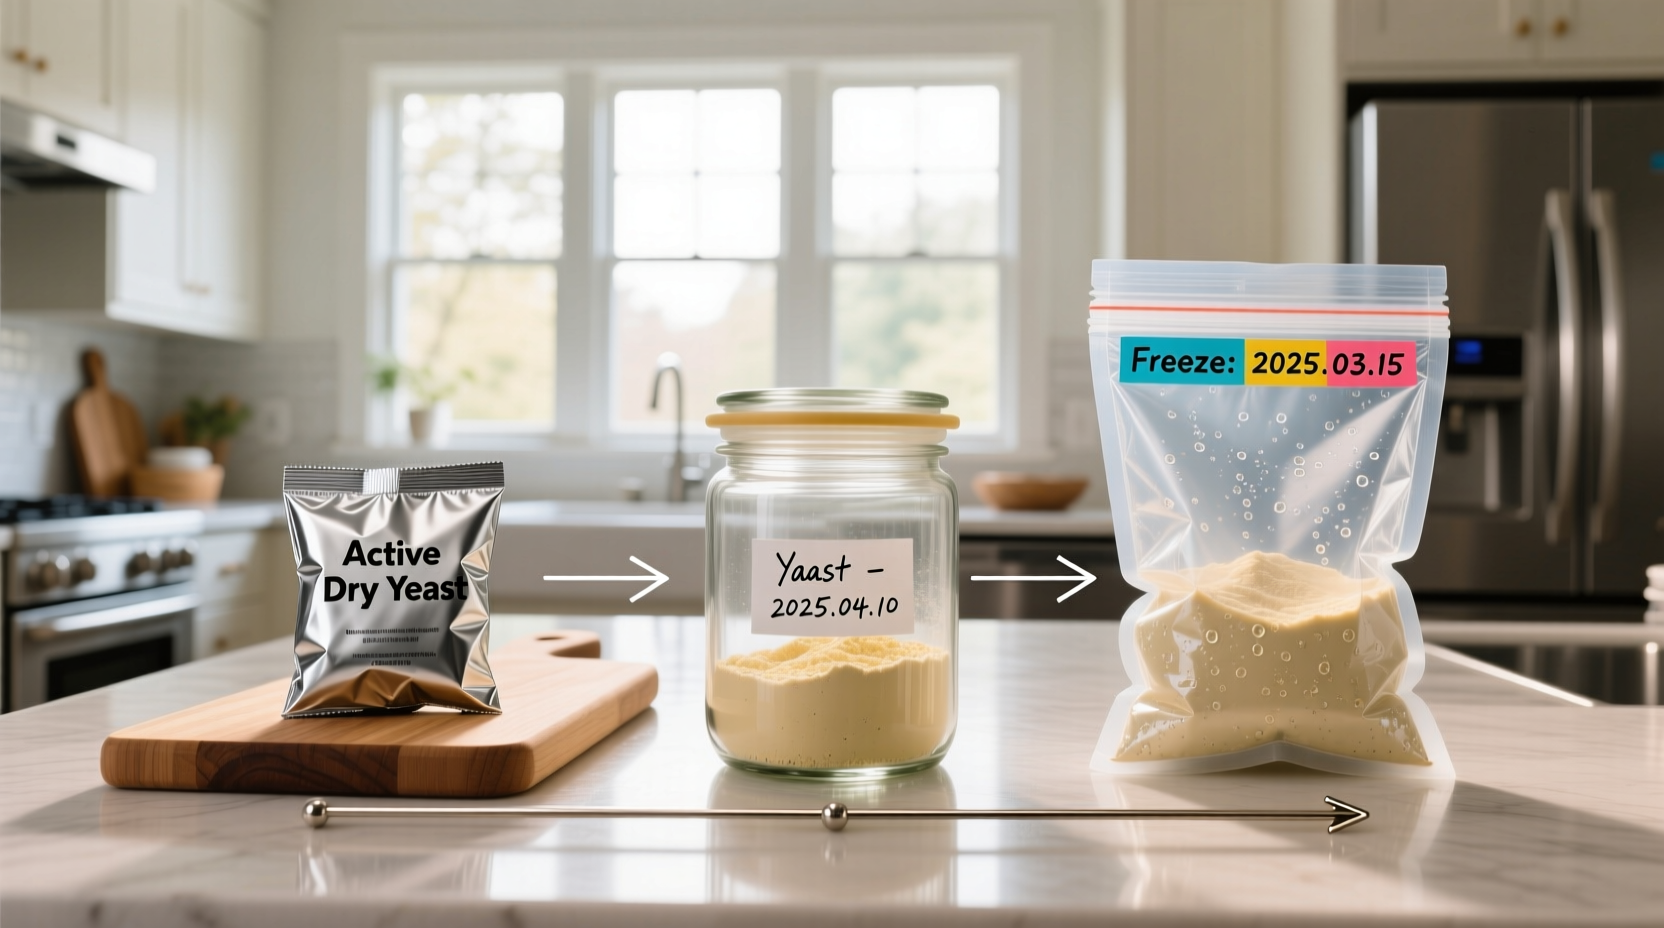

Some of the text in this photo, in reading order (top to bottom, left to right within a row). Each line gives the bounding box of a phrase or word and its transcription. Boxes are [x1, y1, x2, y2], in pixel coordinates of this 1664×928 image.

[1131, 346, 1405, 376] Freeze: 2025.03.15
[342, 539, 441, 566] Active
[776, 551, 852, 587] Yaast
[324, 575, 468, 609] Dry Yeast
[770, 595, 899, 620] 2025.04.10
